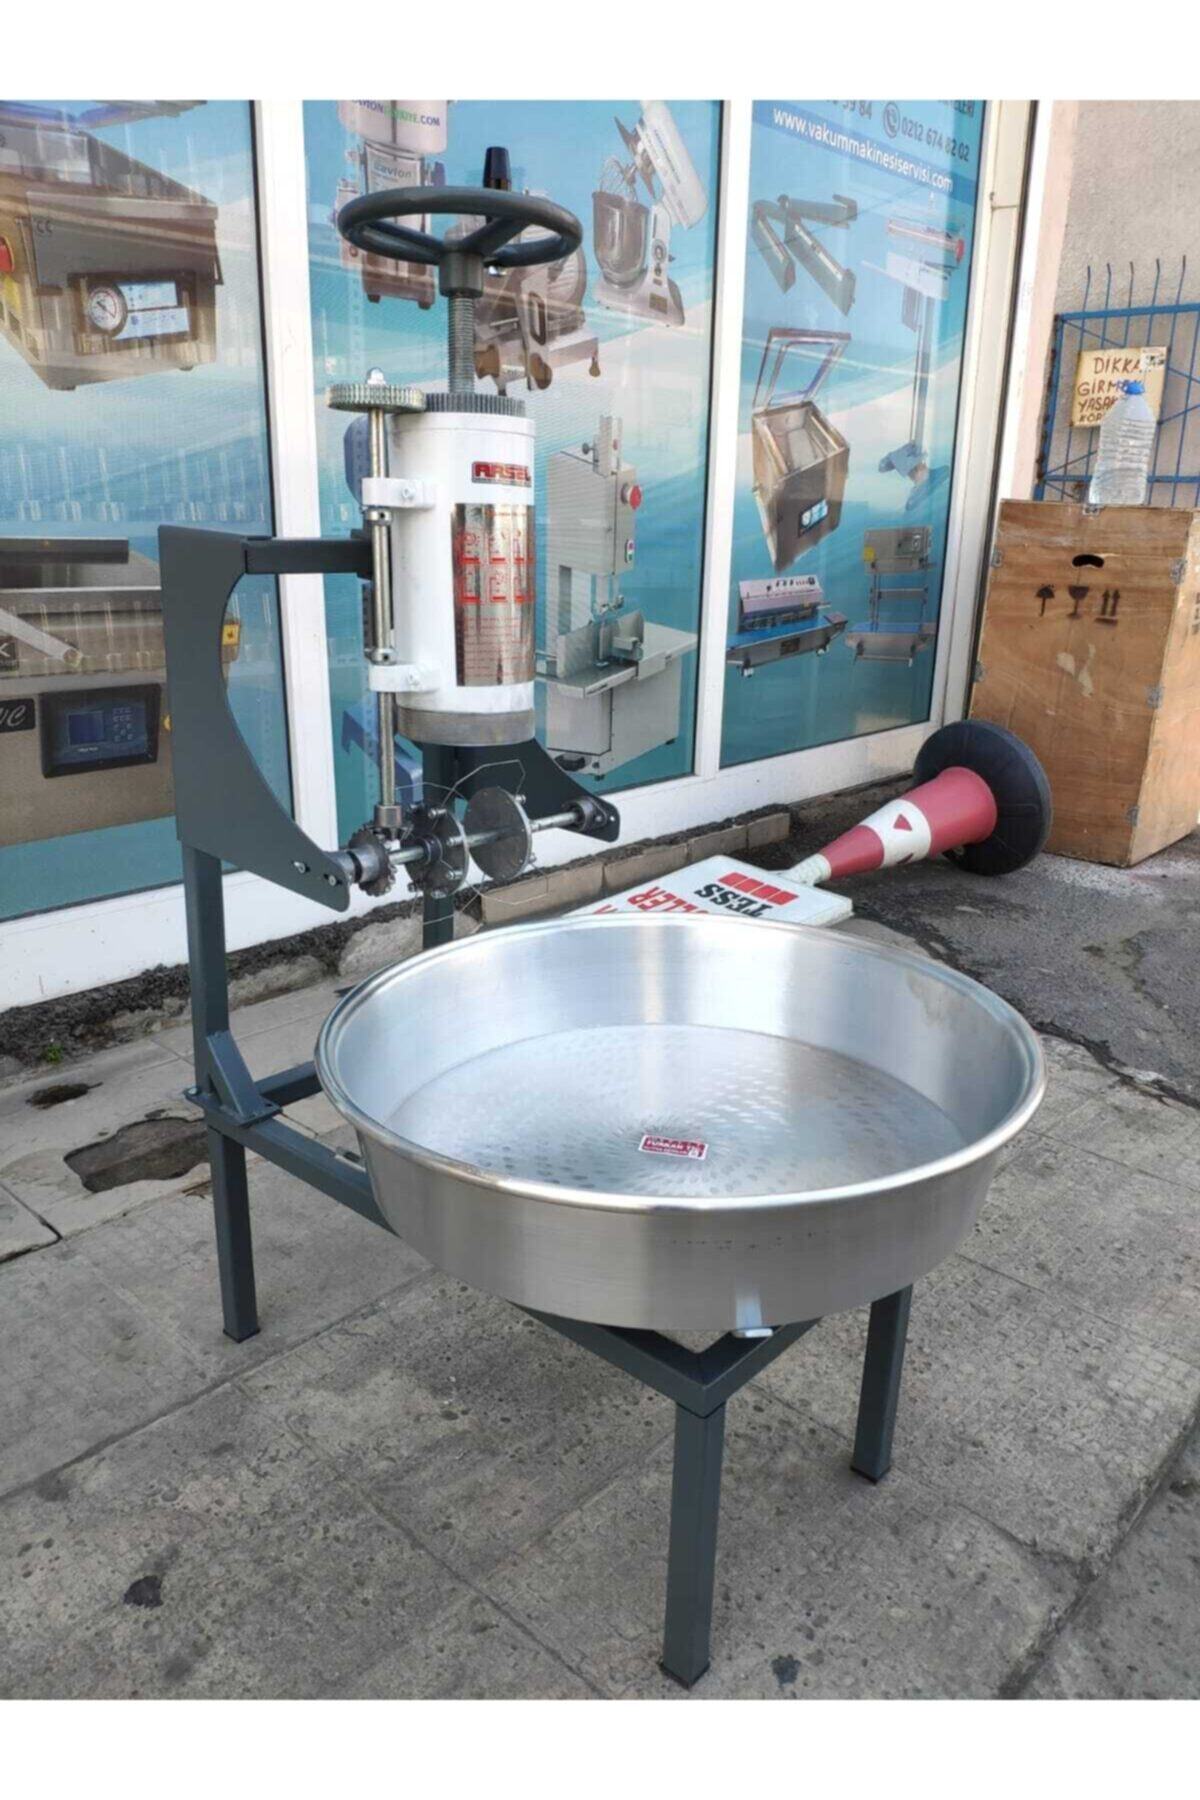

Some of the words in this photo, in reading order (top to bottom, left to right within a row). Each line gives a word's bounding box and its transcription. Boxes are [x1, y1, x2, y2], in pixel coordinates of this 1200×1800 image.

[773, 107, 954, 192] www.vakummakinesiservisi.com
[902, 117, 924, 142] 0212
[927, 128, 943, 149] 674
[958, 141, 970, 162] 02
[1094, 356, 1141, 374] DIKKA
[694, 883, 773, 918] TESS
